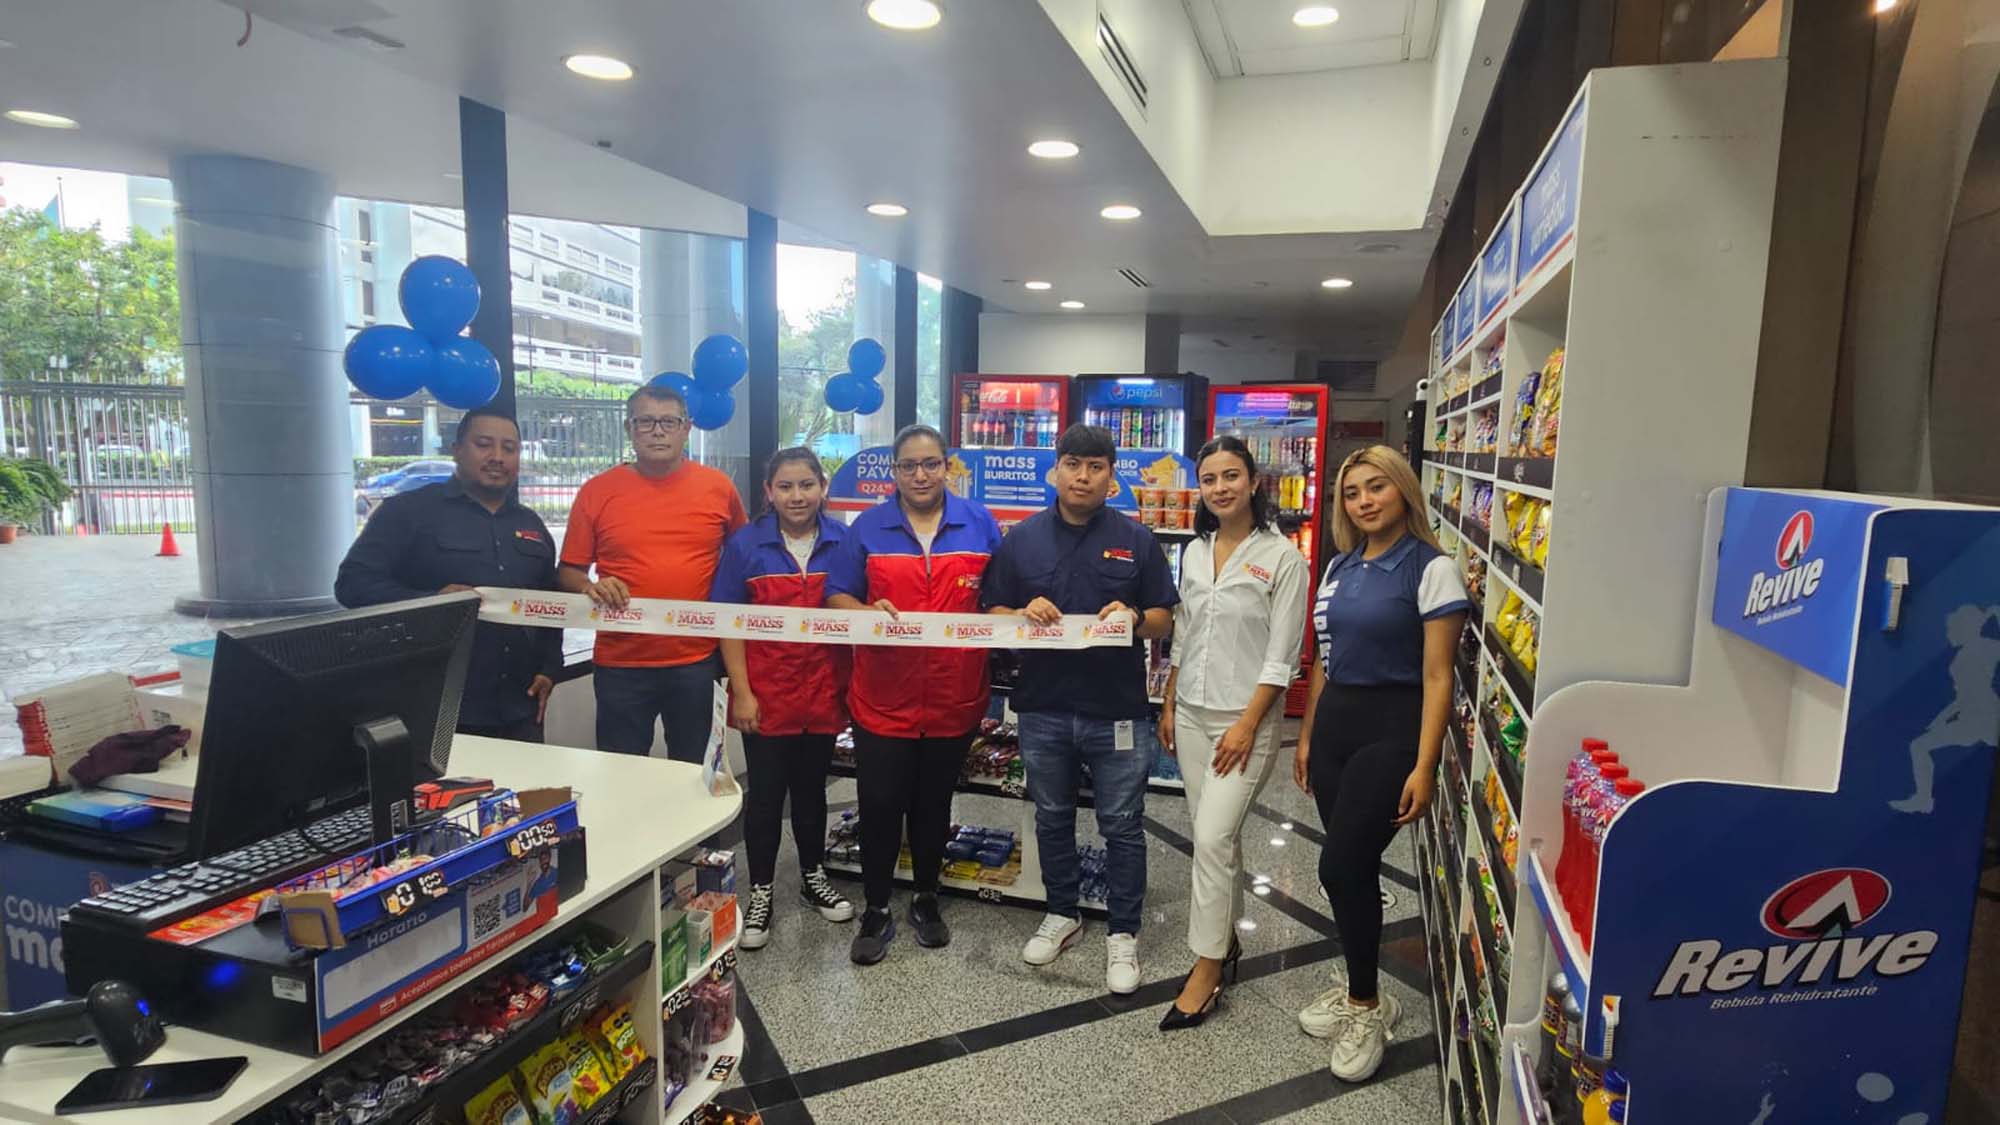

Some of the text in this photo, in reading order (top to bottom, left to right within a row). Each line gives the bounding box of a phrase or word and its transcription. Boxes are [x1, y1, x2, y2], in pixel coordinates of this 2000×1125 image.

[1126, 384, 1163, 400] pepsi
[857, 453, 895, 466] COM
[984, 455, 1036, 469] mass
[984, 470, 1037, 481] BURRITOS
[1743, 557, 1825, 618] Revive
[524, 603, 566, 616] MASS
[602, 607, 643, 621] MASS
[677, 613, 715, 626] MASS
[747, 616, 785, 629] MASS
[812, 621, 849, 633] MASS
[886, 623, 923, 635] MASS
[956, 624, 994, 637] MASS
[366, 911, 428, 949] Horario
[1653, 930, 1939, 998] Revive
[1710, 982, 1879, 1010] Bebida Rehidratante
